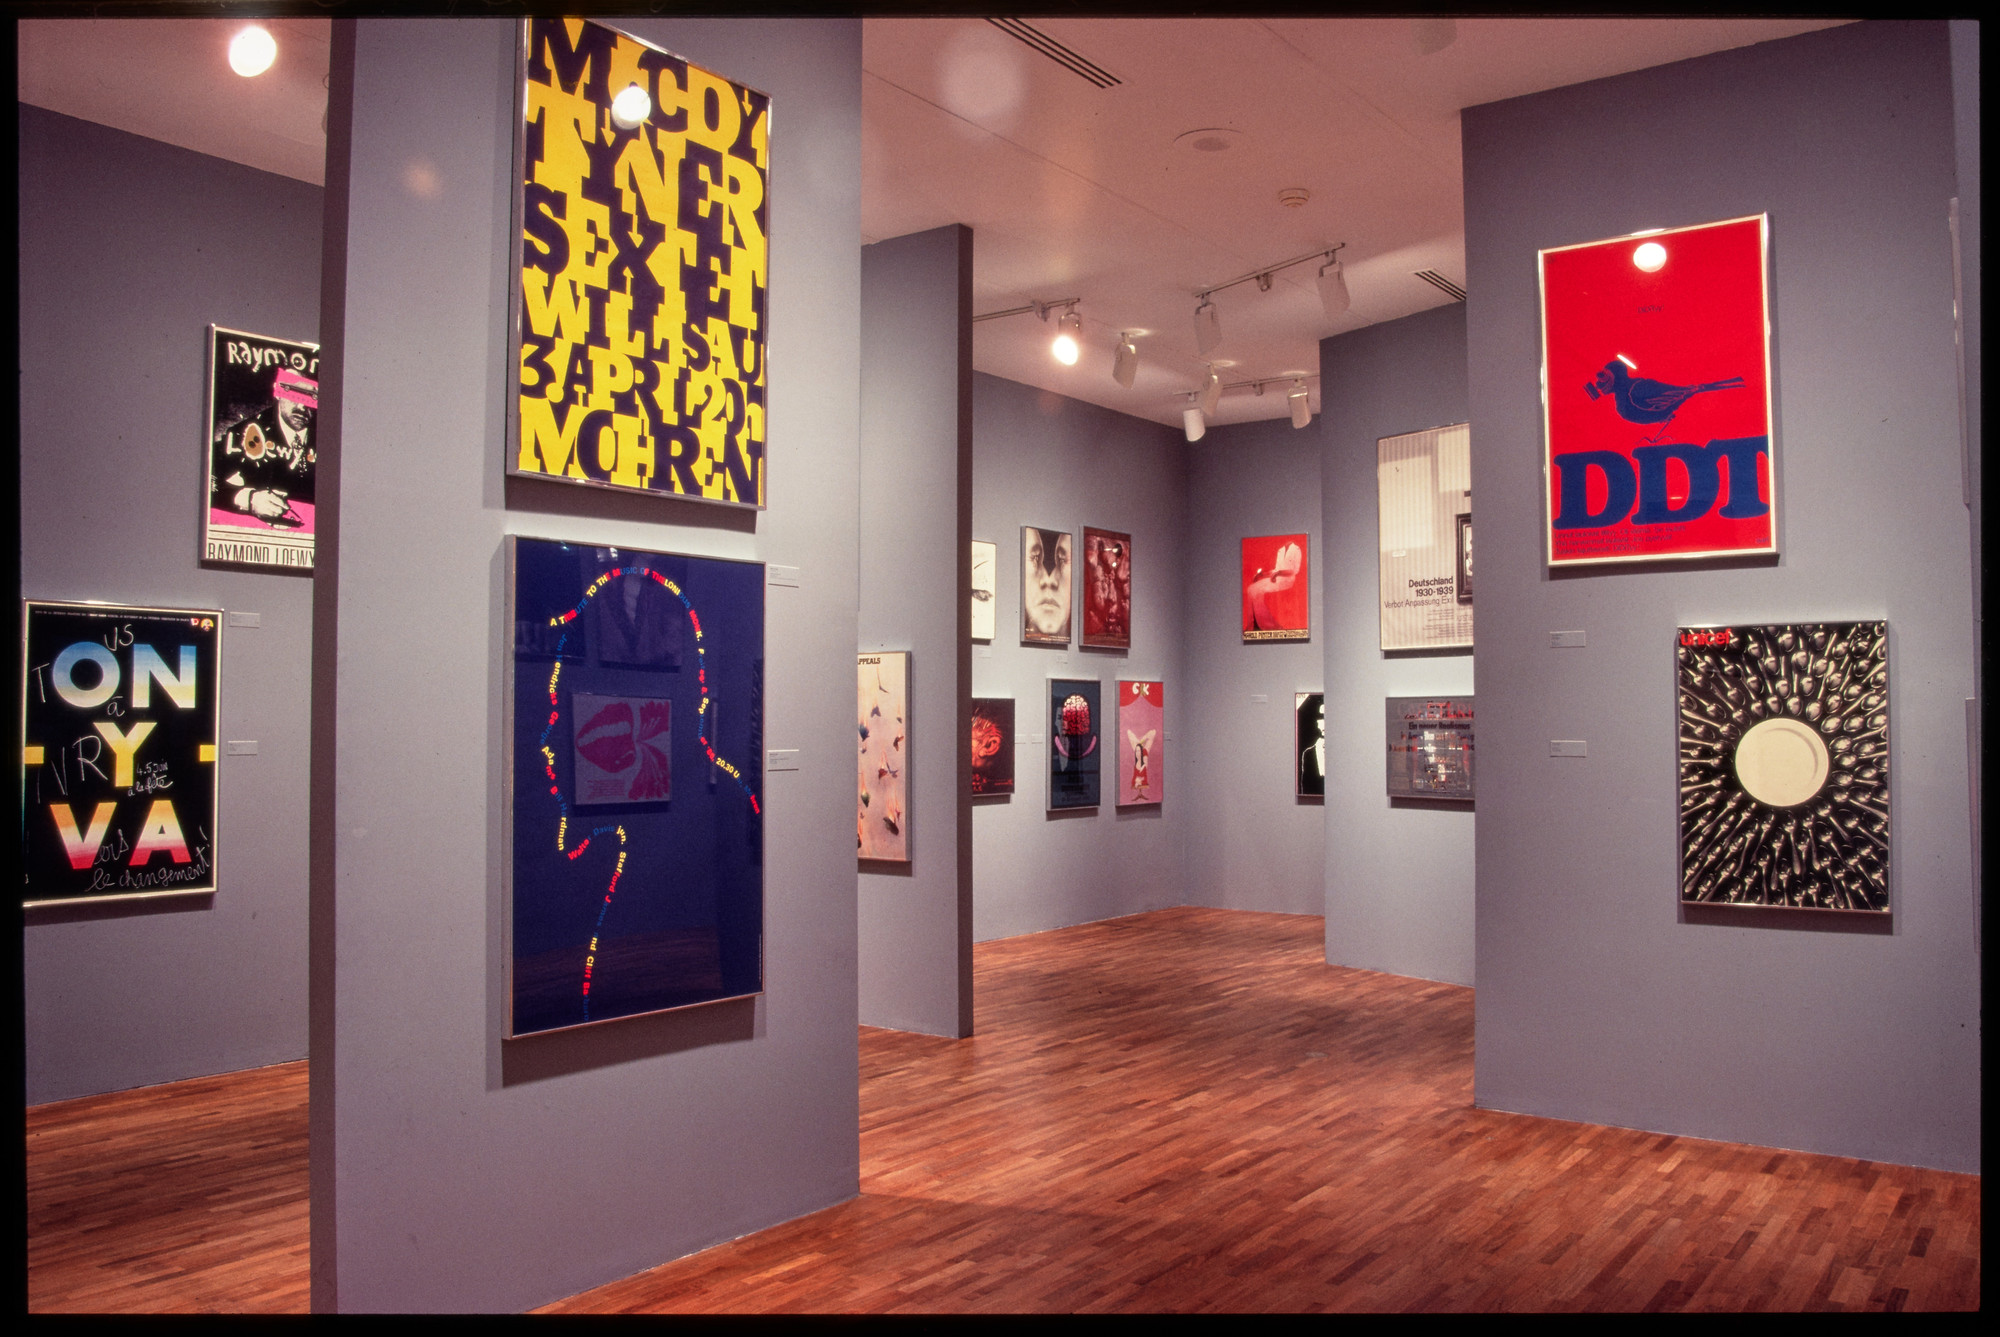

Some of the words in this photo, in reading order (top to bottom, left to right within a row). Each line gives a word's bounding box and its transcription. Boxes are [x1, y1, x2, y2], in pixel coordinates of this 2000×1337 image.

[526, 79, 766, 252] TYNER
[523, 183, 765, 330] SEXTET
[522, 266, 763, 388] WILLISAU
[519, 396, 765, 507] MOHREN
[1552, 434, 1770, 530] DDT
[208, 542, 270, 563] RAYMOND
[1408, 576, 1454, 588] Deutschland
[1384, 600, 1404, 609] Verbot
[1680, 628, 1732, 646] unicef
[52, 641, 197, 709] ON
[549, 617, 558, 627] A
[586, 584, 598, 598] TO
[596, 571, 612, 587] THE
[612, 567, 638, 577] MUSIC
[651, 570, 692, 609] THELONIOUS
[715, 757, 735, 774] 20.30
[549, 654, 563, 705] Hendricks
[592, 825, 615, 837] Davis
[608, 851, 627, 893] Stafford
[50, 800, 192, 869] VA
